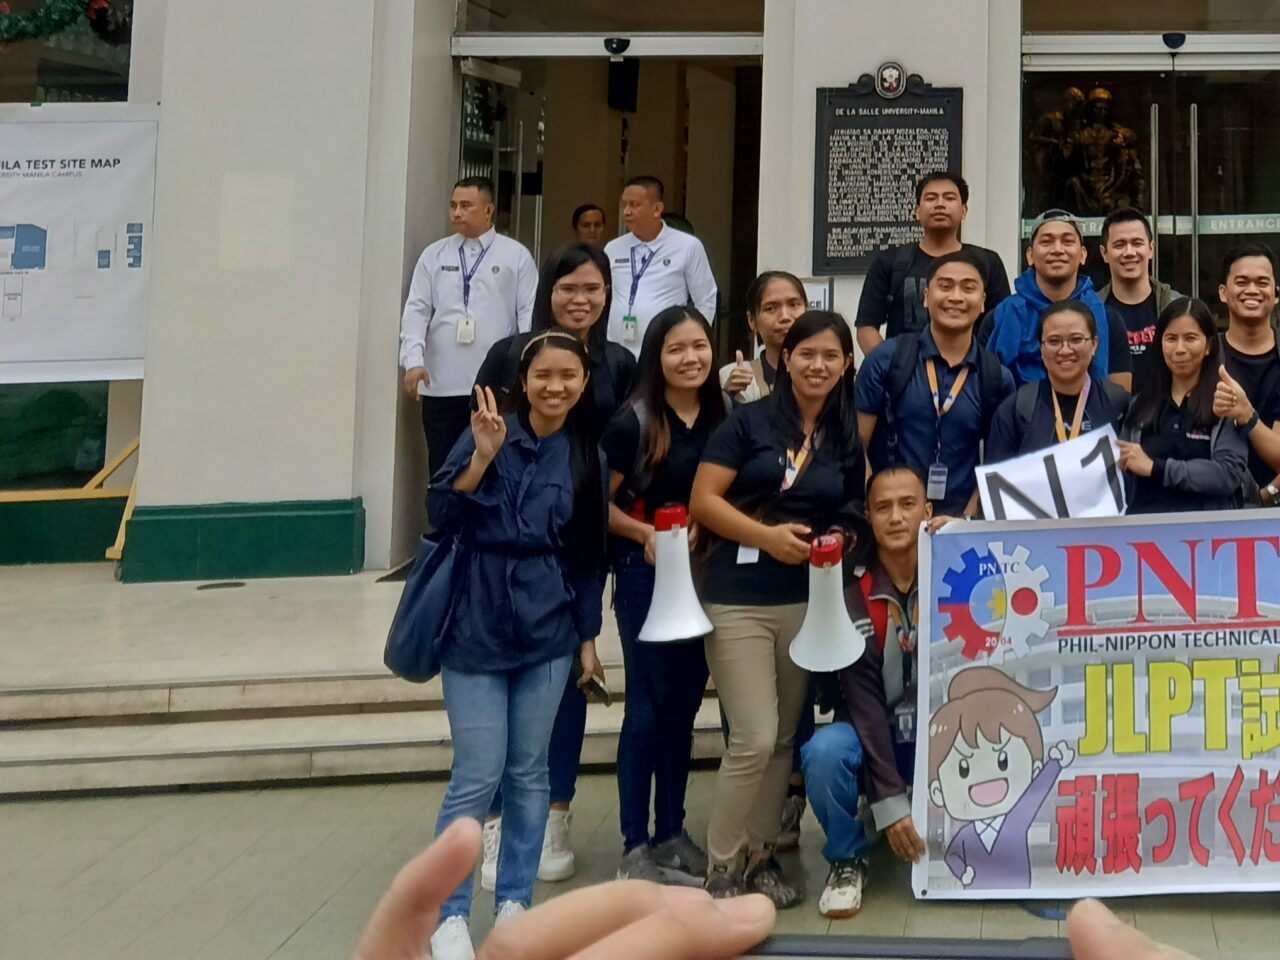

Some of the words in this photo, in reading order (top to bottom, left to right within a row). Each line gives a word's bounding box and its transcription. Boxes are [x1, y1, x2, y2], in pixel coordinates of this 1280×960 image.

[836, 108, 844, 116] DE
[847, 108, 856, 116] LA
[859, 108, 879, 116] SALLE
[0, 160, 21, 170] ILA
[25, 159, 57, 170] TEST
[60, 158, 86, 169] SITE
[90, 158, 121, 169] MAP
[22, 171, 50, 179] MANILA
[52, 170, 82, 178] CAMPUS
[985, 434, 1125, 521] N1
[1057, 633, 1177, 654] PHIL-NIPPON
